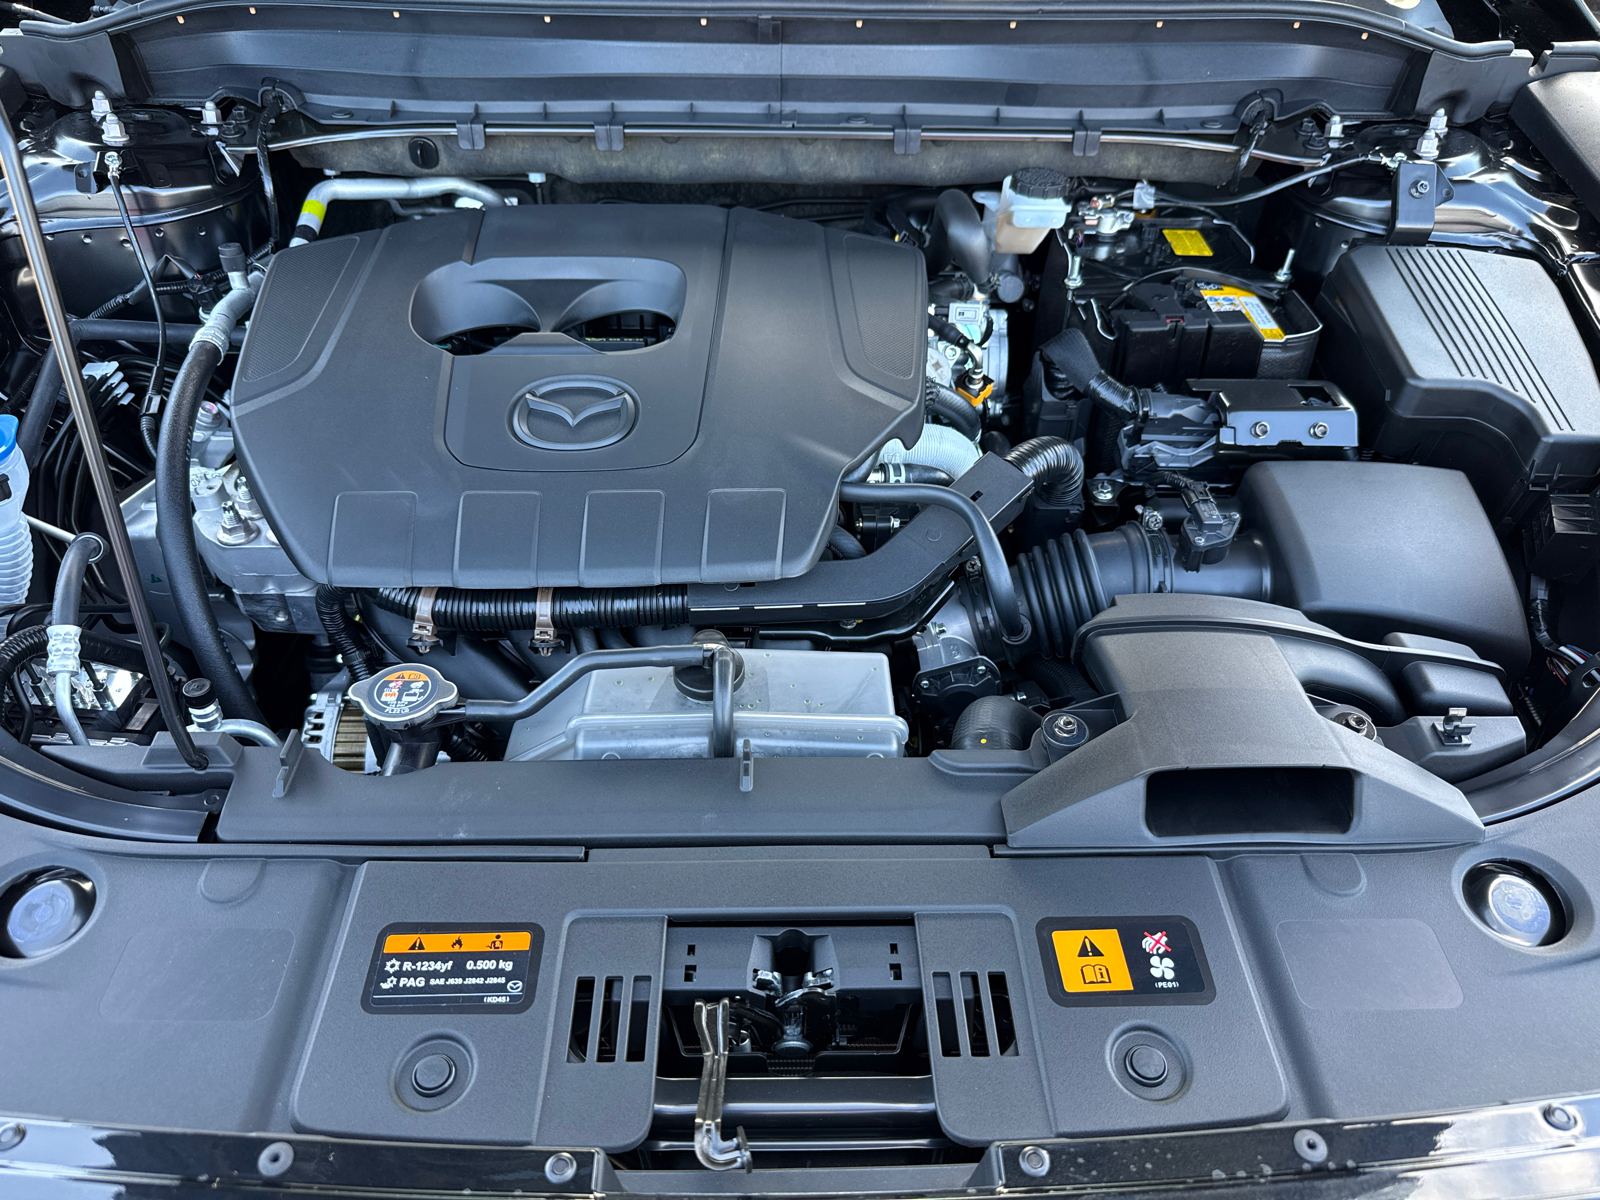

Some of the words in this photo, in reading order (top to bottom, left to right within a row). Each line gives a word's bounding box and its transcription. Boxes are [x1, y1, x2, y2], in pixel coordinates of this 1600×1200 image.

[402, 960, 453, 972] R-1234yf
[466, 960, 497, 970] 0.500
[498, 959, 514, 971] kg
[399, 977, 426, 987] PAG
